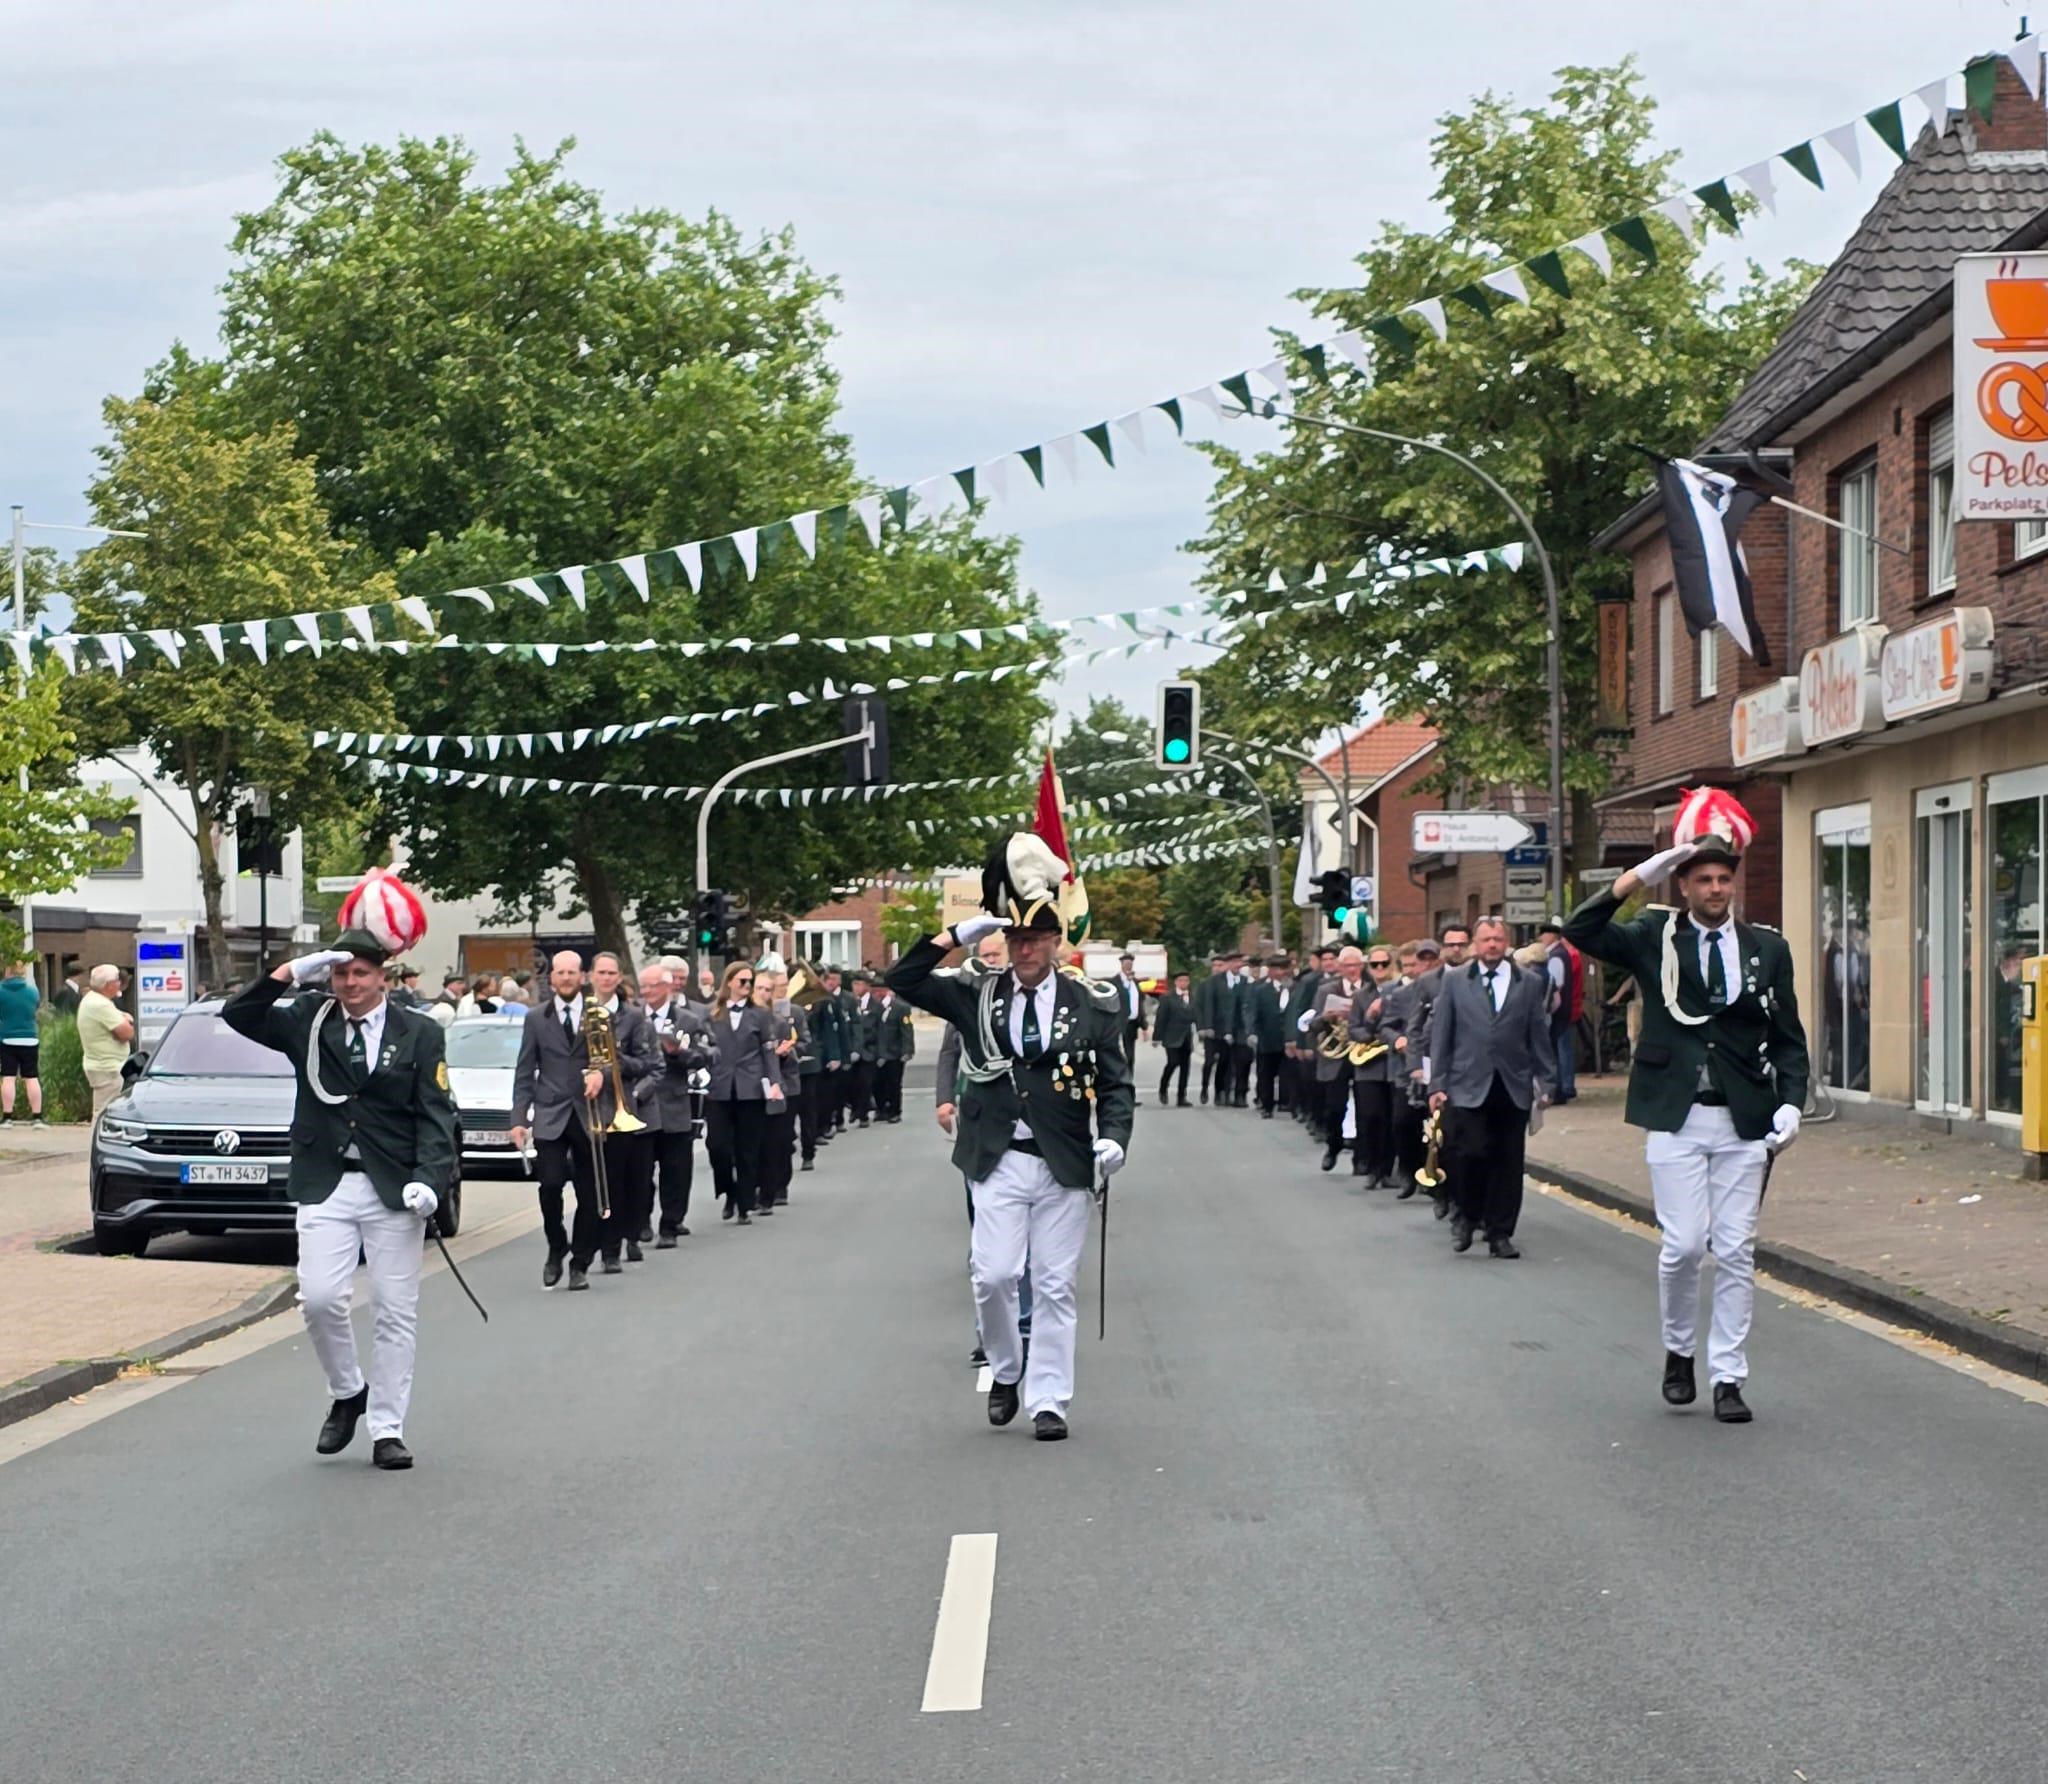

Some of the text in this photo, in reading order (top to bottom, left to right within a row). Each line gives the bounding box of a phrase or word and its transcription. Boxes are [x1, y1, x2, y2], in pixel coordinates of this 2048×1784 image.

[1969, 498, 2041, 512] Parkplatz
[191, 1167, 266, 1180] ST TH 3437
